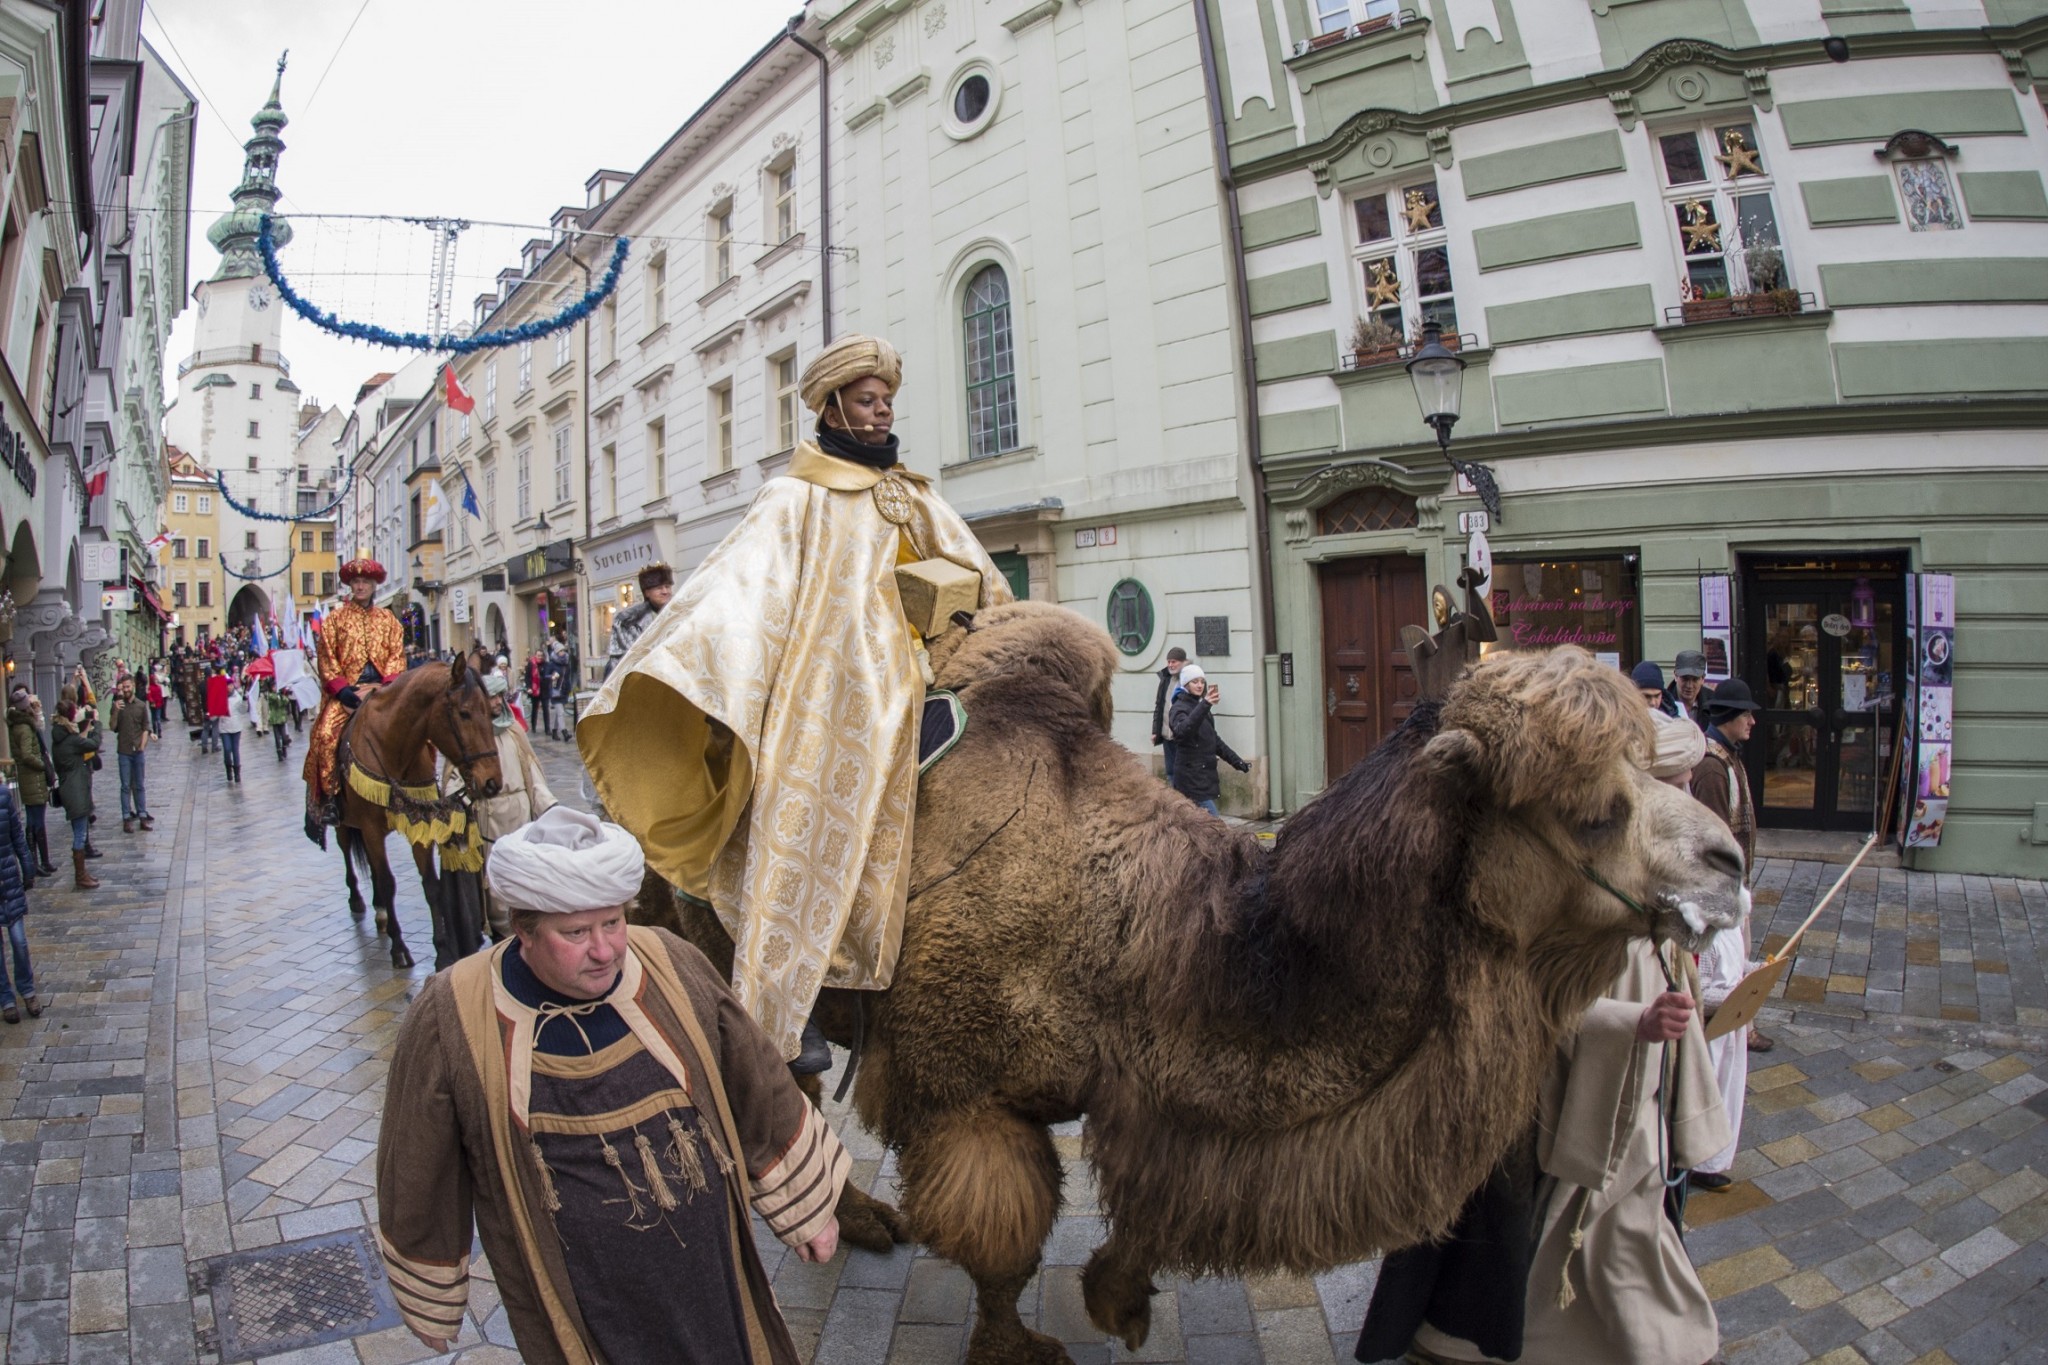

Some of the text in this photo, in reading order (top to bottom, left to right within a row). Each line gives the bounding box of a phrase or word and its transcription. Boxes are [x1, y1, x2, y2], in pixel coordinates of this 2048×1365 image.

[1104, 528, 1110, 541] 8
[454, 589, 465, 620] IVKO
[1568, 599, 1588, 611] na
[1591, 591, 1634, 618] korze
